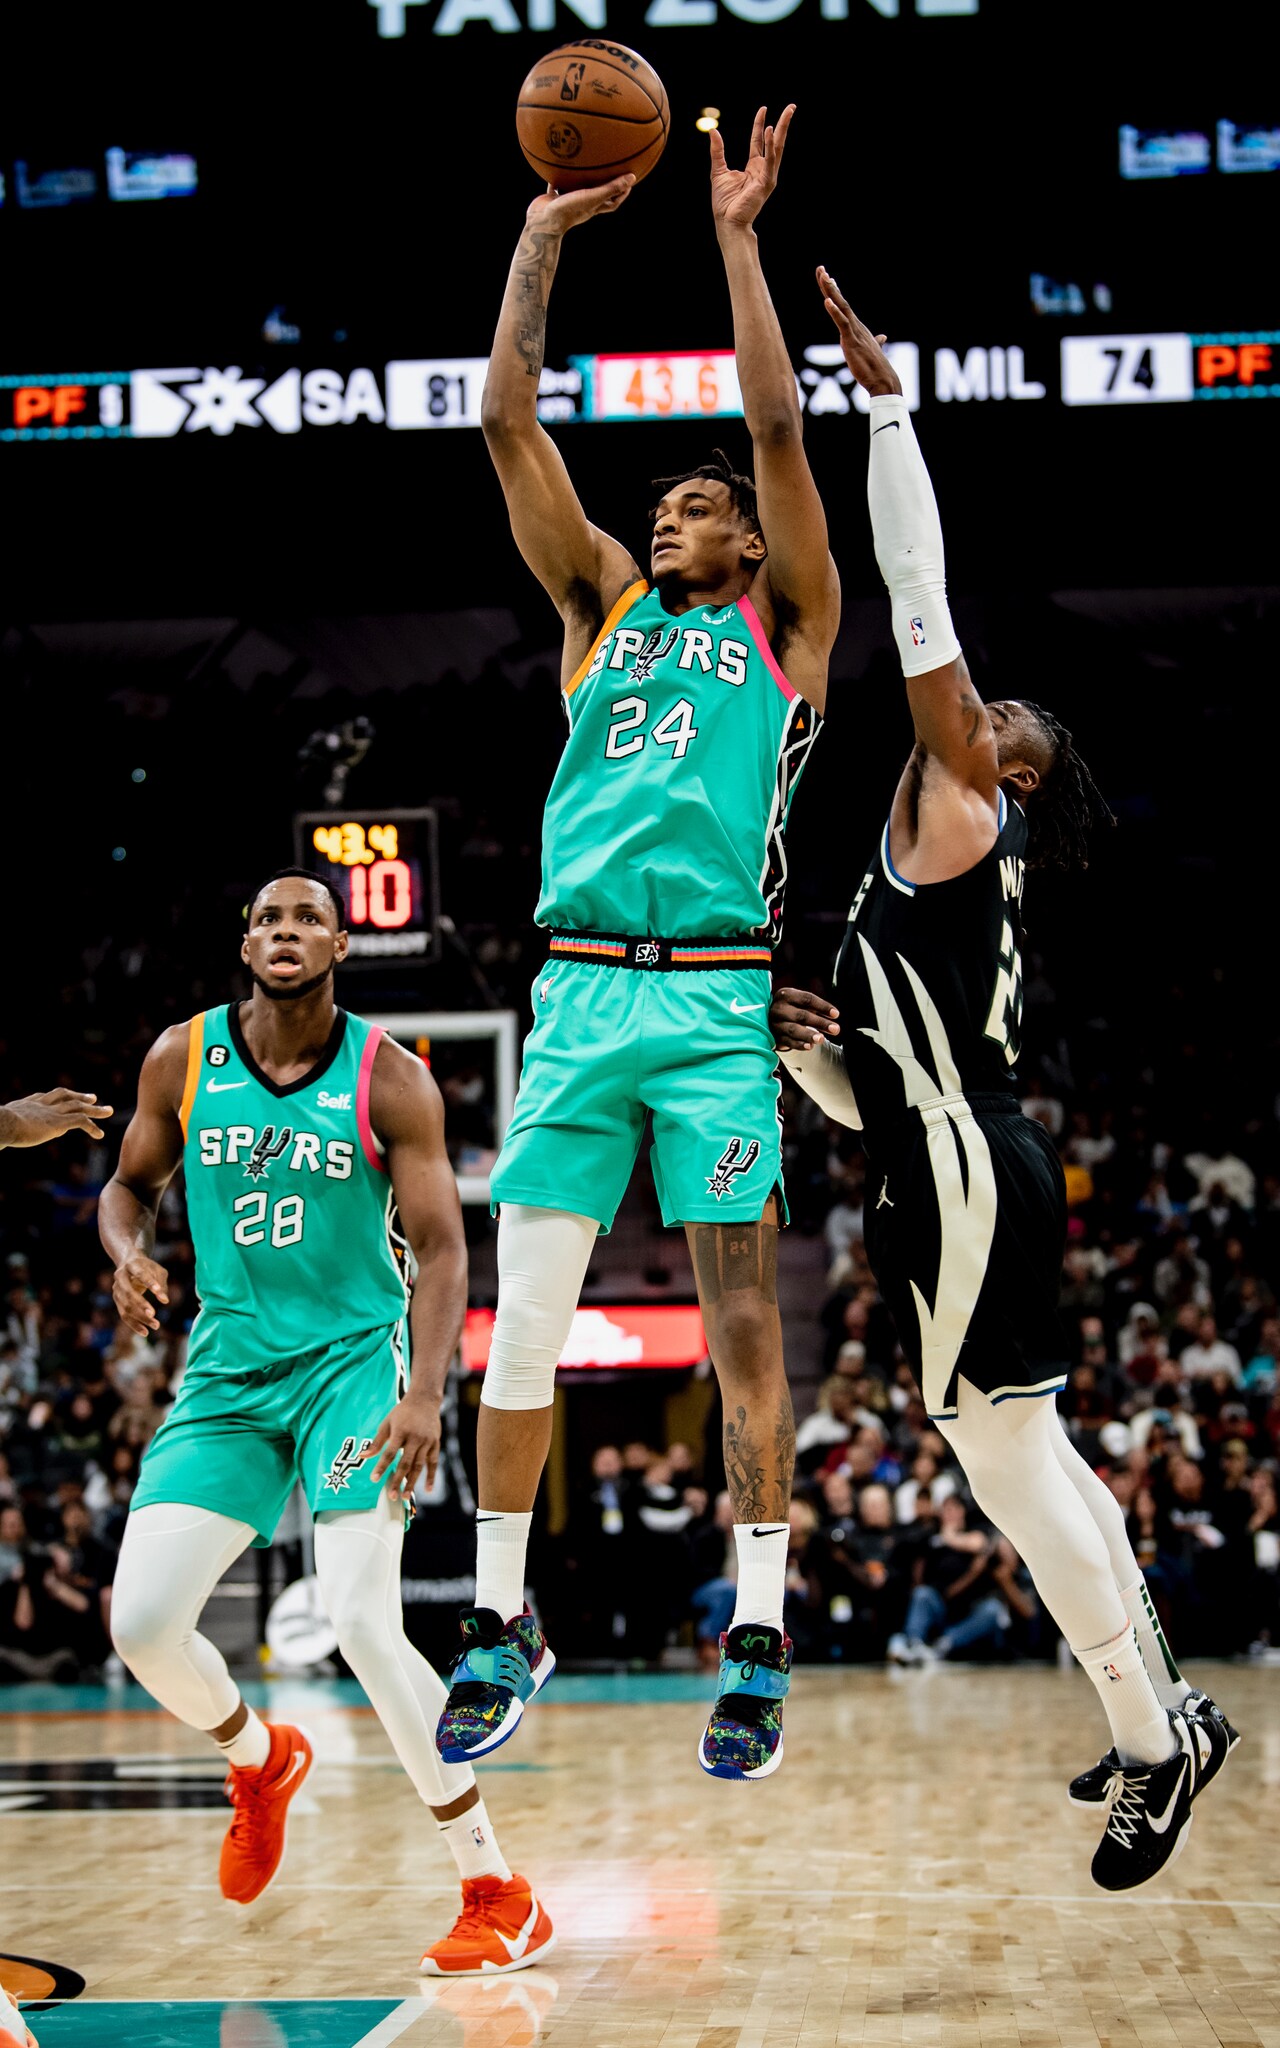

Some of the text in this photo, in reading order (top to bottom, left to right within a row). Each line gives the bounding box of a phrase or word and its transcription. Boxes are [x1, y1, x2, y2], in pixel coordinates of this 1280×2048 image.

[625, 364, 718, 415] 43.6
[934, 346, 1155, 402] MIL 74
[1199, 344, 1272, 387] PF
[13, 386, 86, 428] PF
[302, 368, 467, 426] SA 81
[587, 626, 749, 687] SPURS
[604, 694, 699, 760] 24
[313, 822, 399, 866] 43.4
[351, 860, 412, 928] 10
[209, 1047, 226, 1065] 6
[316, 1090, 352, 1111] Self.
[199, 1125, 355, 1183] SPURS
[233, 1191, 305, 1249] 28
